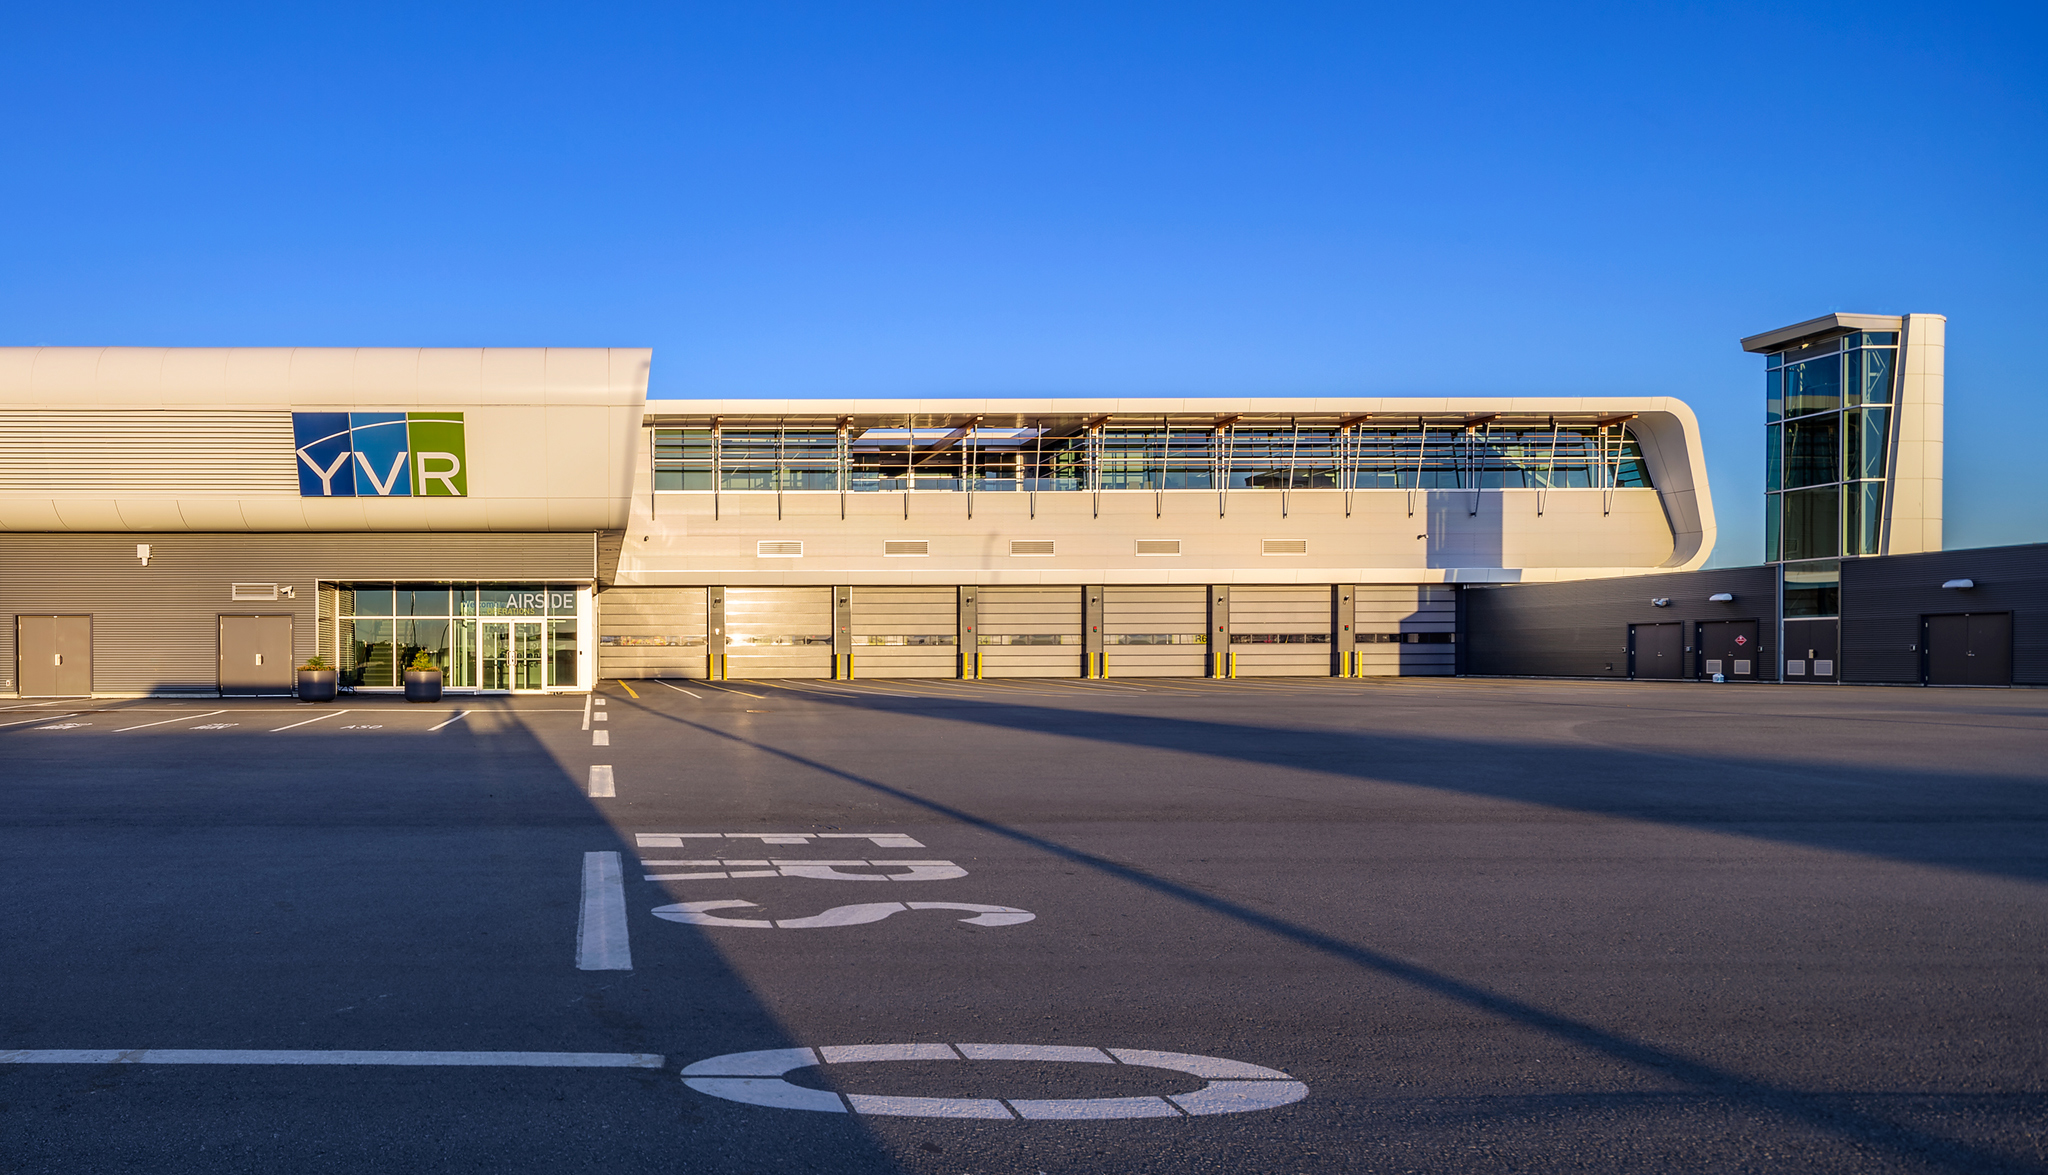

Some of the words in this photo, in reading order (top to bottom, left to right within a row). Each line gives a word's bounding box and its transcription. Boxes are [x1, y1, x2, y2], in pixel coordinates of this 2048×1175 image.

[297, 450, 461, 495] YVR
[462, 600, 499, 608] Wecome
[506, 593, 574, 608] AIRSIDE
